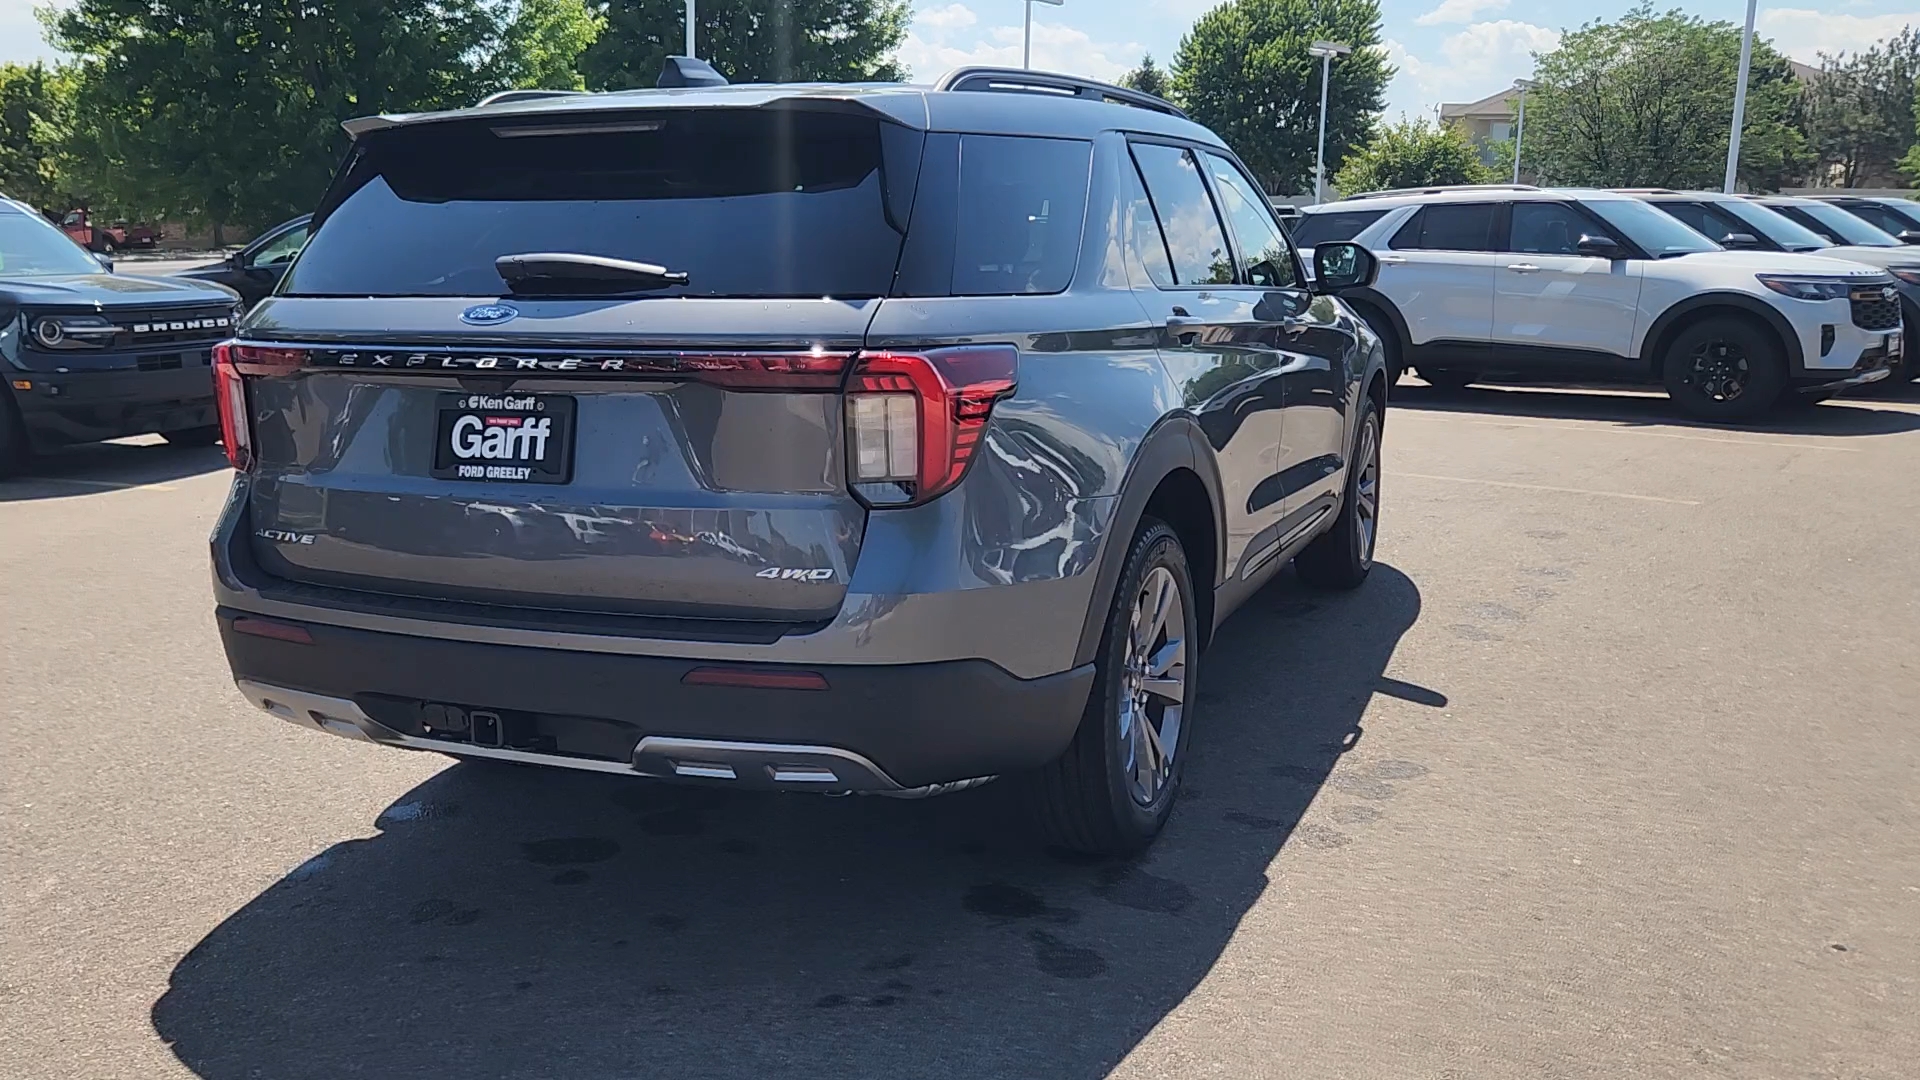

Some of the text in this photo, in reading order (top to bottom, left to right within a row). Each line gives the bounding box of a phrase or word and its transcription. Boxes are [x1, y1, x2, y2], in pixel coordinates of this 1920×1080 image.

[467, 305, 515, 320] Ford
[133, 318, 229, 333] BRONCO
[339, 353, 624, 370] EXPLORER
[479, 396, 535, 410] Ken Garff
[451, 414, 551, 460] Garff
[458, 465, 531, 480] FORD GREELEY
[255, 528, 315, 545] ACTIVE
[755, 567, 834, 582] 4WD
